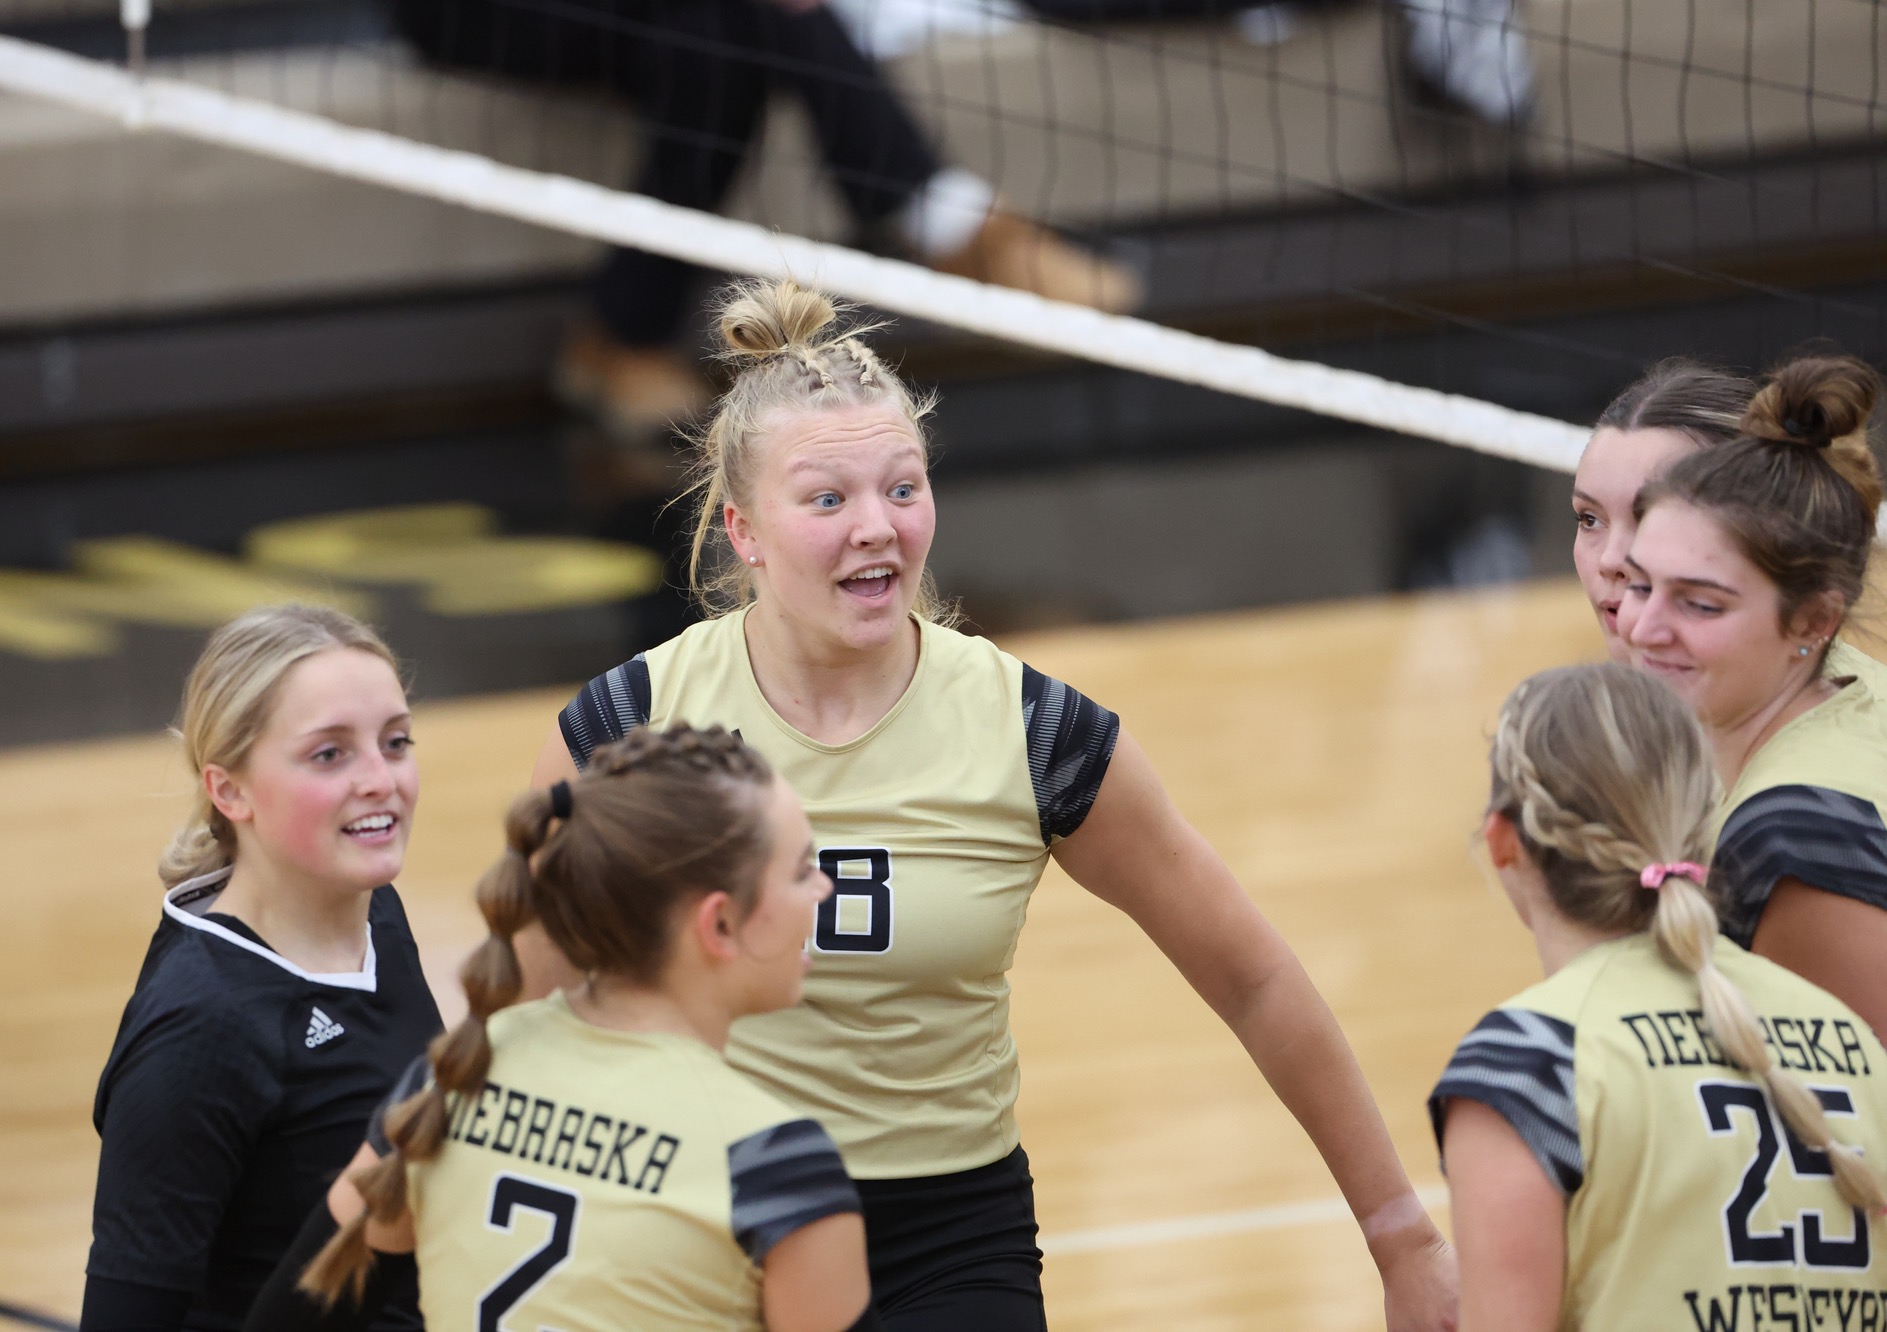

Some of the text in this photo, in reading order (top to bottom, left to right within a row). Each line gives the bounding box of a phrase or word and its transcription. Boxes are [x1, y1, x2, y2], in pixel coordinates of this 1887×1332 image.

[804, 846, 894, 955] 8
[305, 1023, 344, 1048] adidas
[1620, 1010, 1870, 1075] NEBSKA
[1696, 1079, 1870, 1271] 25
[474, 1171, 582, 1332] 2
[1684, 1285, 1887, 1332] WESEYA
